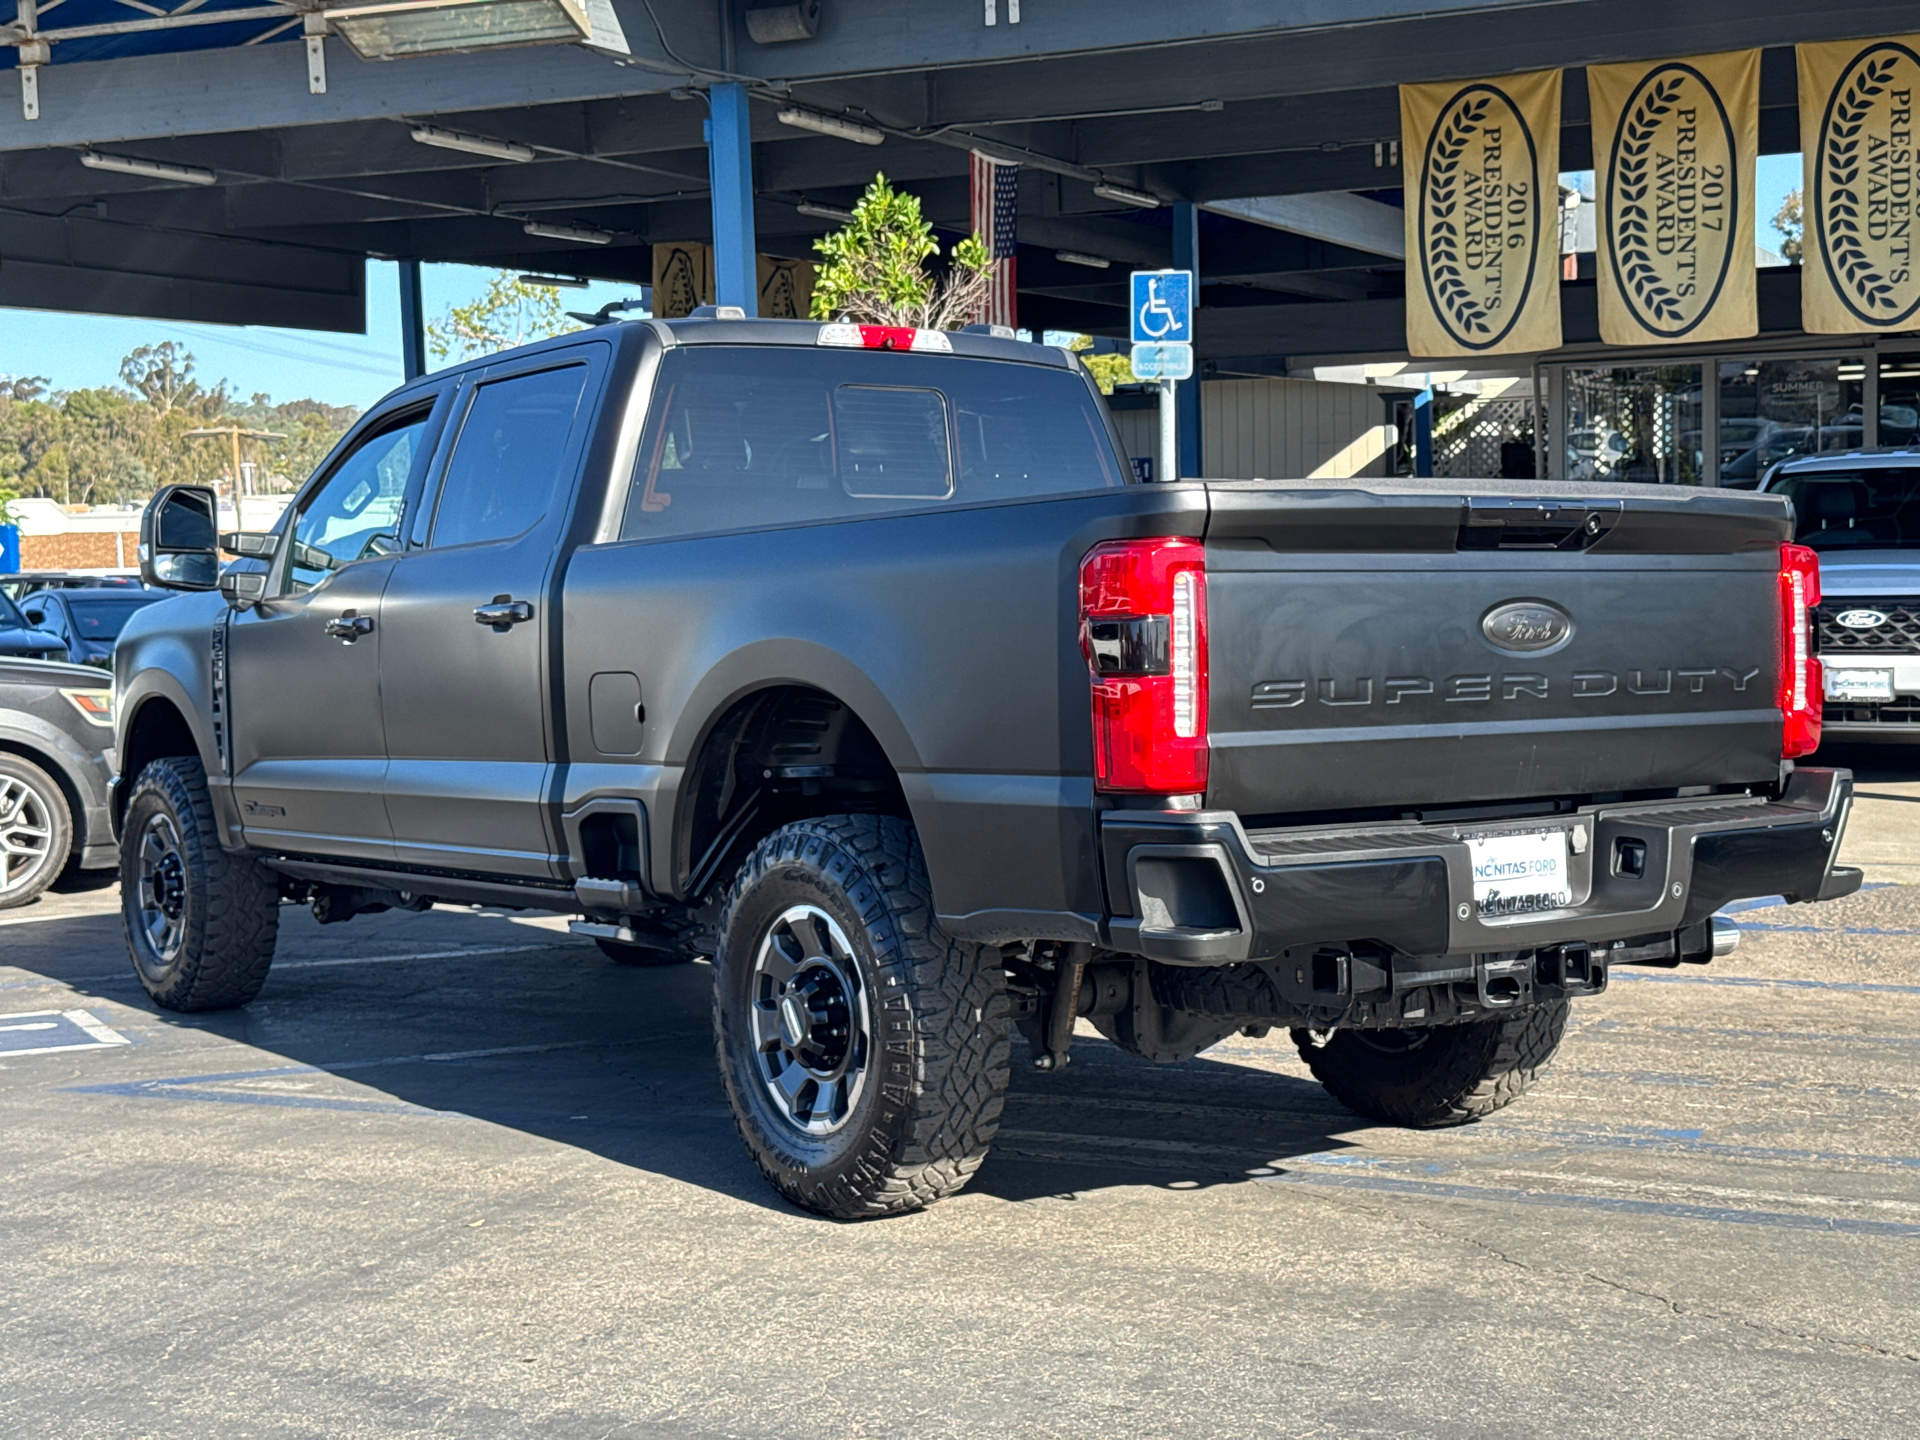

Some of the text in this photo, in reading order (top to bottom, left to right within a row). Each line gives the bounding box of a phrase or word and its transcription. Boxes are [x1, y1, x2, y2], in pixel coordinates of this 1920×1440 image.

[1464, 171, 1482, 271] AWARD
[1483, 126, 1502, 311] PRESIDENT'S
[1507, 182, 1528, 249] 2016
[1656, 151, 1675, 257] AWARD
[1677, 106, 1696, 297] PRESIDENT'S
[1701, 165, 1724, 233] 2017
[1868, 134, 1888, 242] AWARD
[1890, 87, 1911, 284] PRESIDENT'S
[1771, 381, 1824, 393] SUMMER
[1250, 667, 1760, 709] SUPER DUTY
[1472, 861, 1526, 878] NCINITAS
[1529, 858, 1557, 873] FORD
